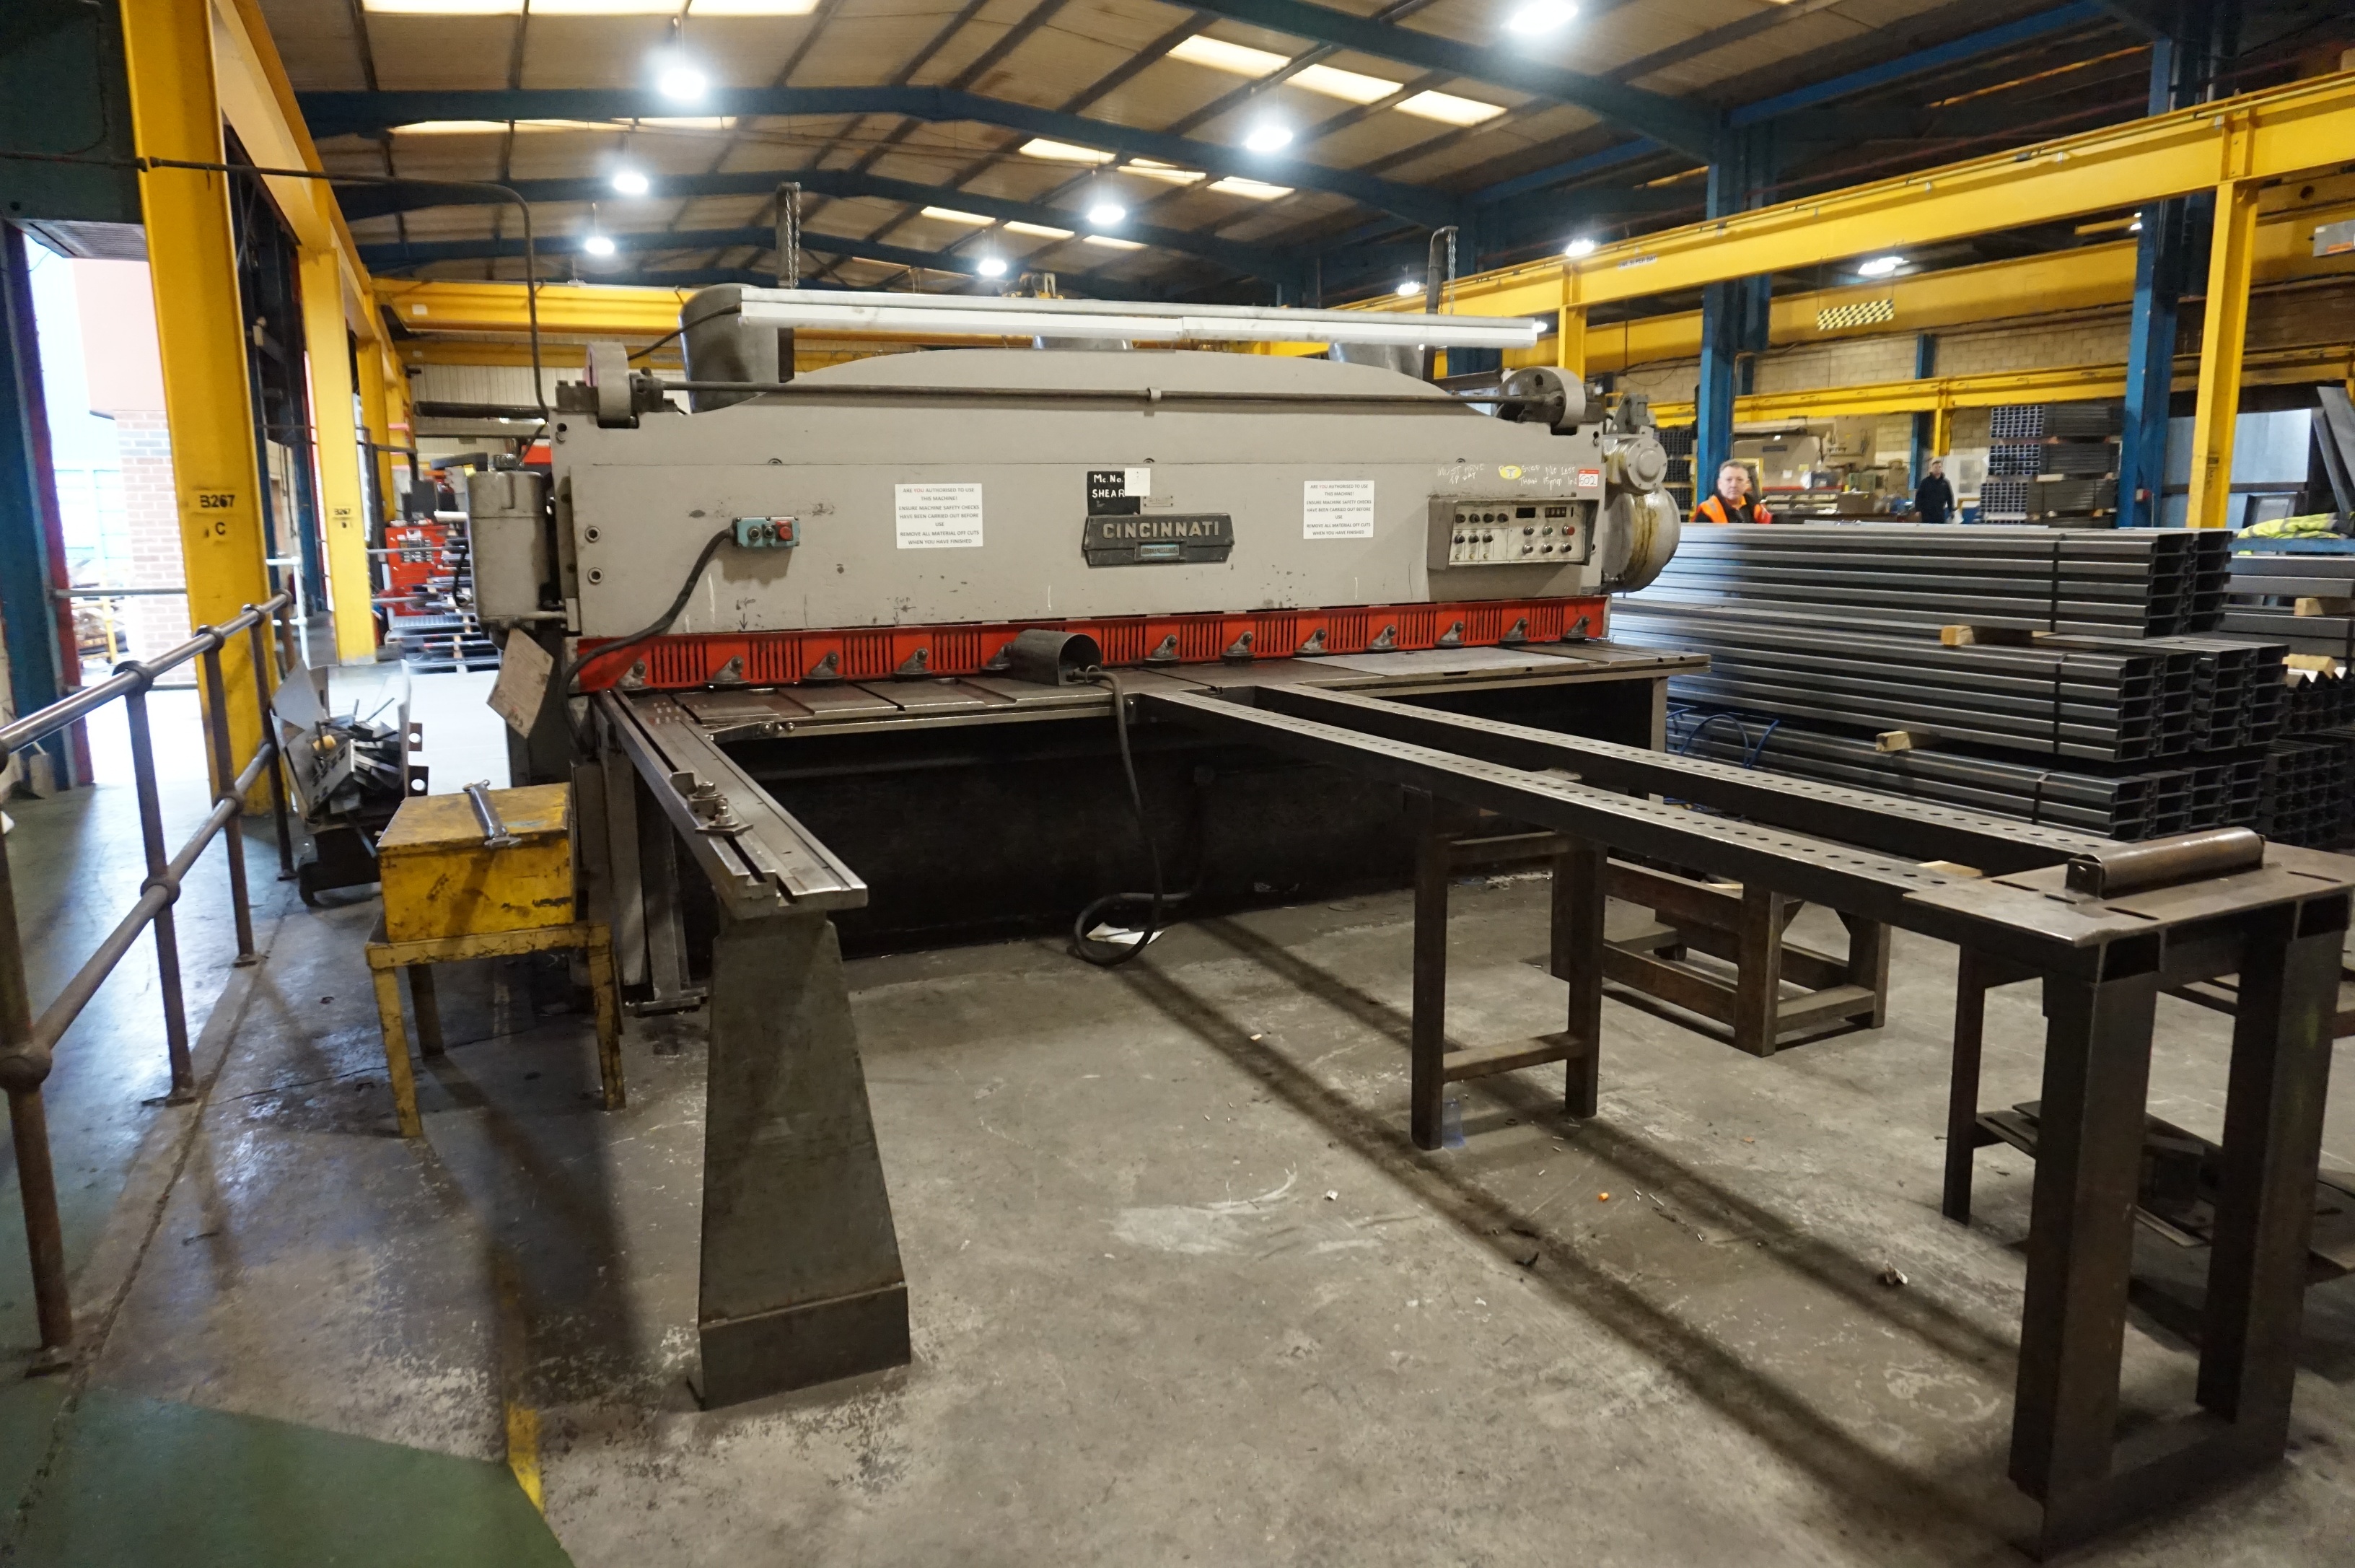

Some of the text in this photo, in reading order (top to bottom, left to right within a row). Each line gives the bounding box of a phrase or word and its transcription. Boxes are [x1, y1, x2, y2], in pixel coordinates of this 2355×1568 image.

[1438, 463, 1484, 477] MUST HAVE
[1093, 474, 1108, 483] Mc.
[1579, 475, 1596, 485] 602
[1092, 489, 1125, 498] SHEAR
[200, 495, 235, 508] B267
[215, 522, 226, 535] C
[1103, 521, 1219, 539] CINCINNATI
